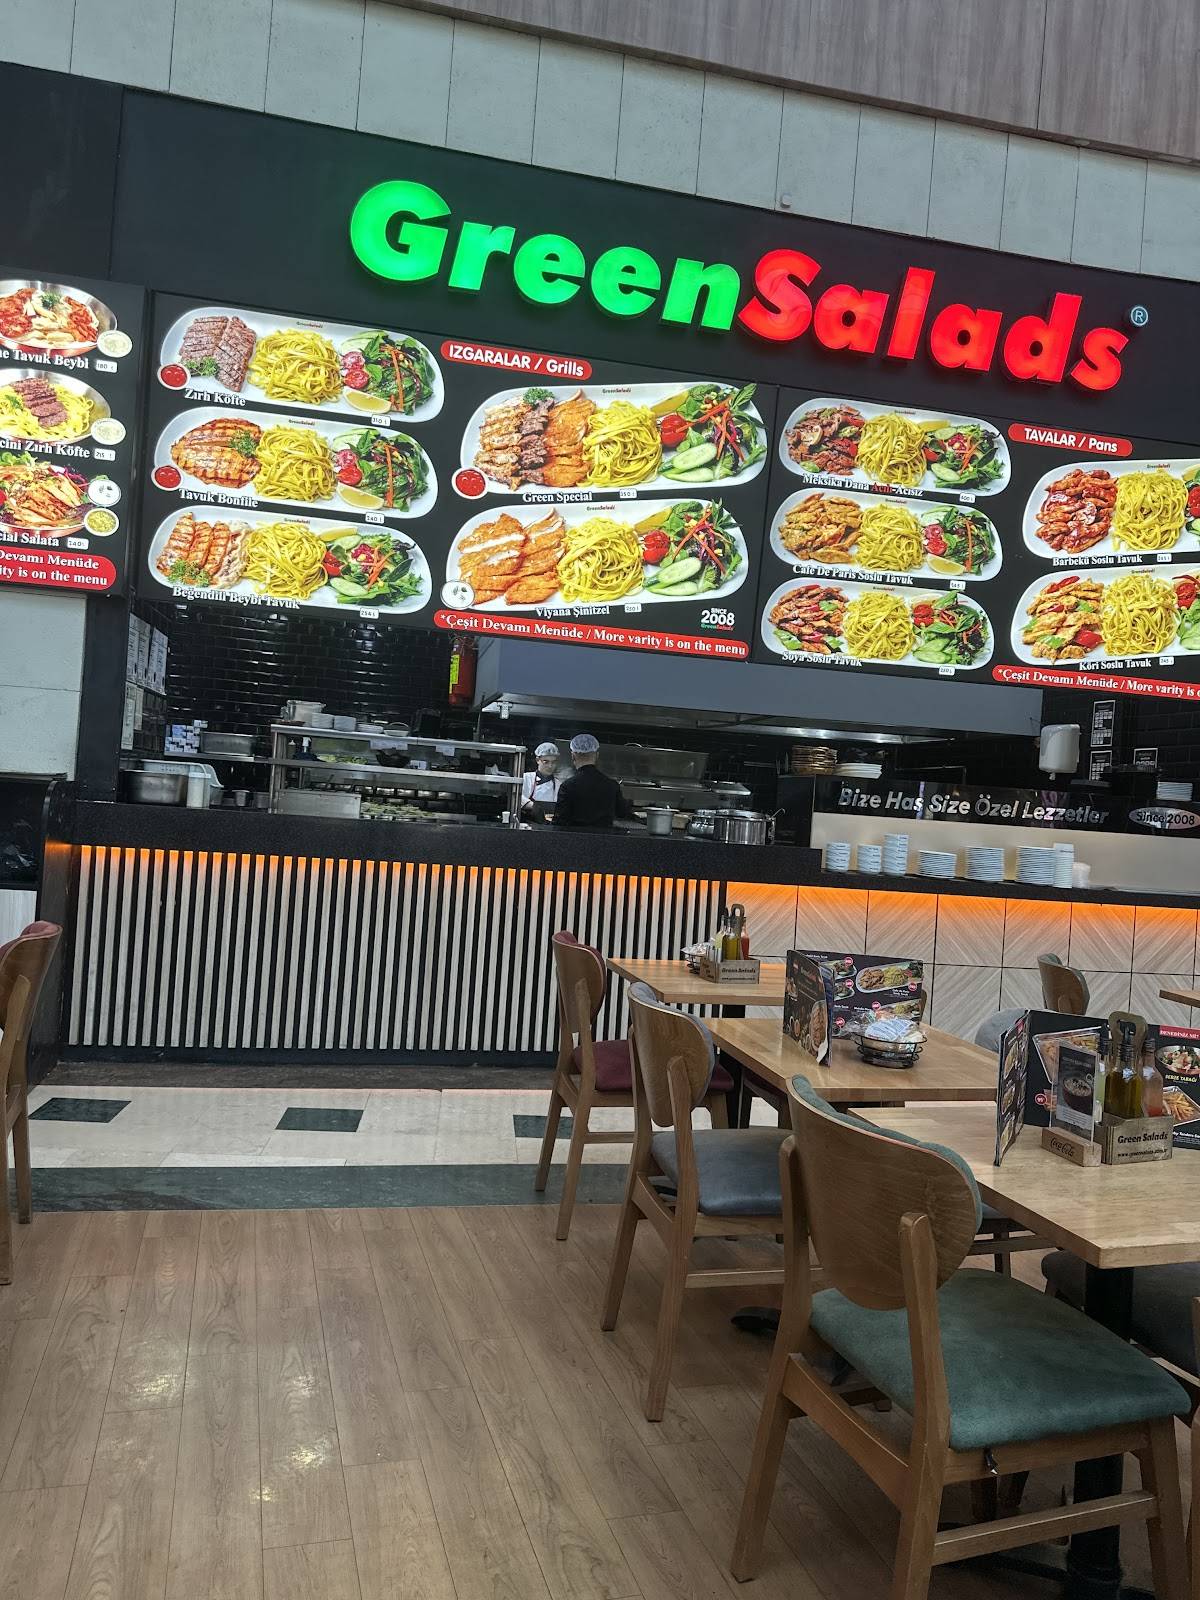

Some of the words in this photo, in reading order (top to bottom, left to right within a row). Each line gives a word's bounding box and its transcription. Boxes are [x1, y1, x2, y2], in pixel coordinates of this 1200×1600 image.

[12, 349, 51, 365] Tavuk
[449, 344, 531, 369] IZGARALAR
[534, 358, 543, 370] /
[546, 359, 584, 377] Grills
[184, 388, 211, 401] Zırh
[214, 392, 246, 406] Köfte
[1024, 427, 1076, 447] TAVALAR
[1078, 436, 1086, 448] /
[1089, 438, 1117, 452] Pans
[24, 440, 53, 454] Zırh
[55, 444, 91, 458] Köfte
[802, 473, 843, 488] Meksika
[845, 479, 870, 491] Dana
[178, 488, 215, 503] Tavuk
[217, 493, 259, 508] Bonfile
[522, 492, 554, 503] Green
[556, 491, 593, 504] Special
[21, 532, 59, 547] Salata
[47, 554, 99, 569] Menüde
[1053, 555, 1090, 567] Barbekü
[1091, 554, 1114, 565] Soslu
[1116, 553, 1143, 563] Tavuk
[18, 567, 28, 577] is
[31, 570, 47, 579] on
[50, 570, 70, 581] the
[73, 574, 107, 585] menu
[792, 563, 815, 575] Cafe
[817, 566, 831, 577] De
[832, 568, 856, 579] Paris
[857, 571, 883, 582] Soslu
[885, 573, 914, 585] Tavuk
[263, 596, 300, 609] Tavuk
[535, 607, 571, 619] Viyana
[573, 605, 610, 618] Şinitzel
[701, 609, 735, 626] 2008
[482, 618, 531, 633] Devamı
[534, 623, 583, 639] Menüde
[585, 629, 592, 639] /
[593, 629, 625, 642] More
[628, 635, 662, 648] varity
[665, 637, 674, 648] is
[677, 640, 691, 649] on
[694, 640, 711, 651] the
[715, 644, 745, 655] menu
[782, 651, 805, 663] Soya
[806, 654, 832, 664] Soslu
[833, 655, 862, 667] Tavuk
[1100, 660, 1123, 670] Soslu
[1125, 658, 1152, 668] Tavuk
[1033, 672, 1074, 685] Devamı
[1076, 676, 1119, 689] Menüde
[1120, 680, 1126, 690] /
[1127, 681, 1153, 692] More
[1156, 685, 1185, 698] varity
[1187, 686, 1195, 697] is
[838, 786, 882, 808] Bize
[885, 790, 924, 811] Has
[928, 794, 971, 815] Size
[975, 793, 1019, 818] Özel
[1022, 801, 1110, 824] Lezzetler
[1136, 810, 1166, 823] Since
[1166, 811, 1196, 825] 2008
[1117, 1135, 1142, 1144] Green
[1142, 1131, 1168, 1142] Salads
